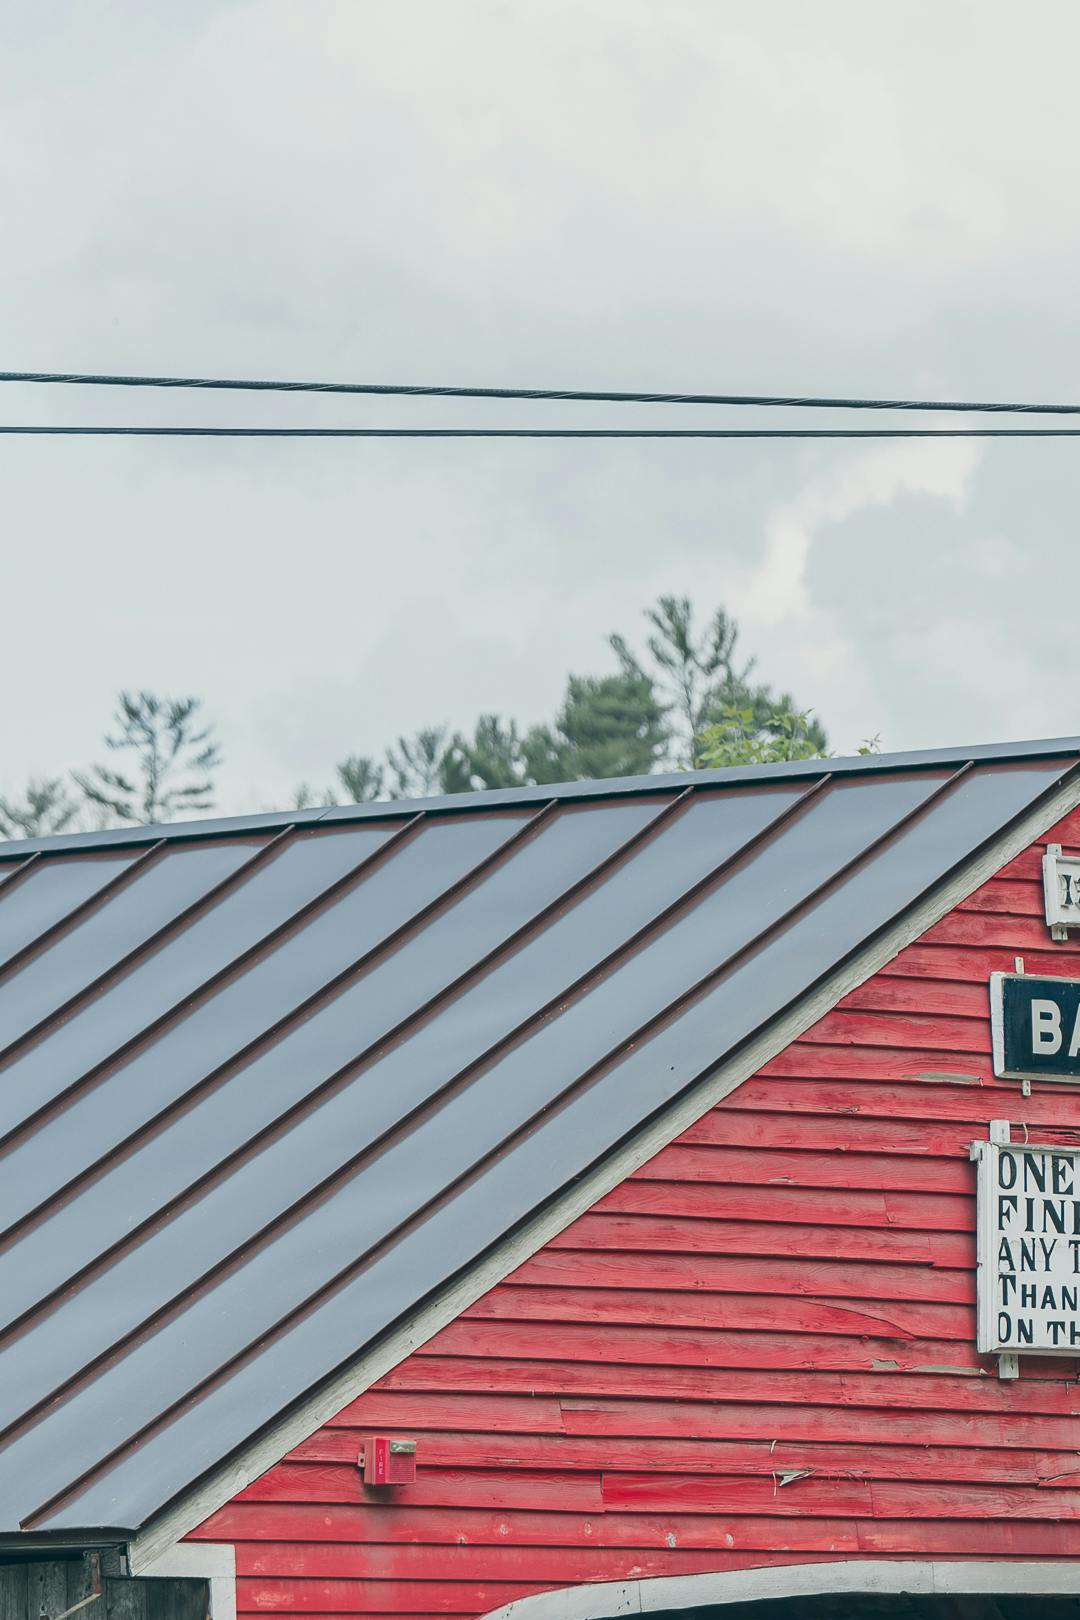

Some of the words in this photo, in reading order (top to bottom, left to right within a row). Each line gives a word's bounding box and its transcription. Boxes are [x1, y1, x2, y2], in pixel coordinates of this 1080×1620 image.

[998, 1151, 1075, 1196] ONE
[998, 1237, 1058, 1272] ANY
[998, 1273, 1078, 1311] THAN
[998, 1311, 1034, 1344] ON
